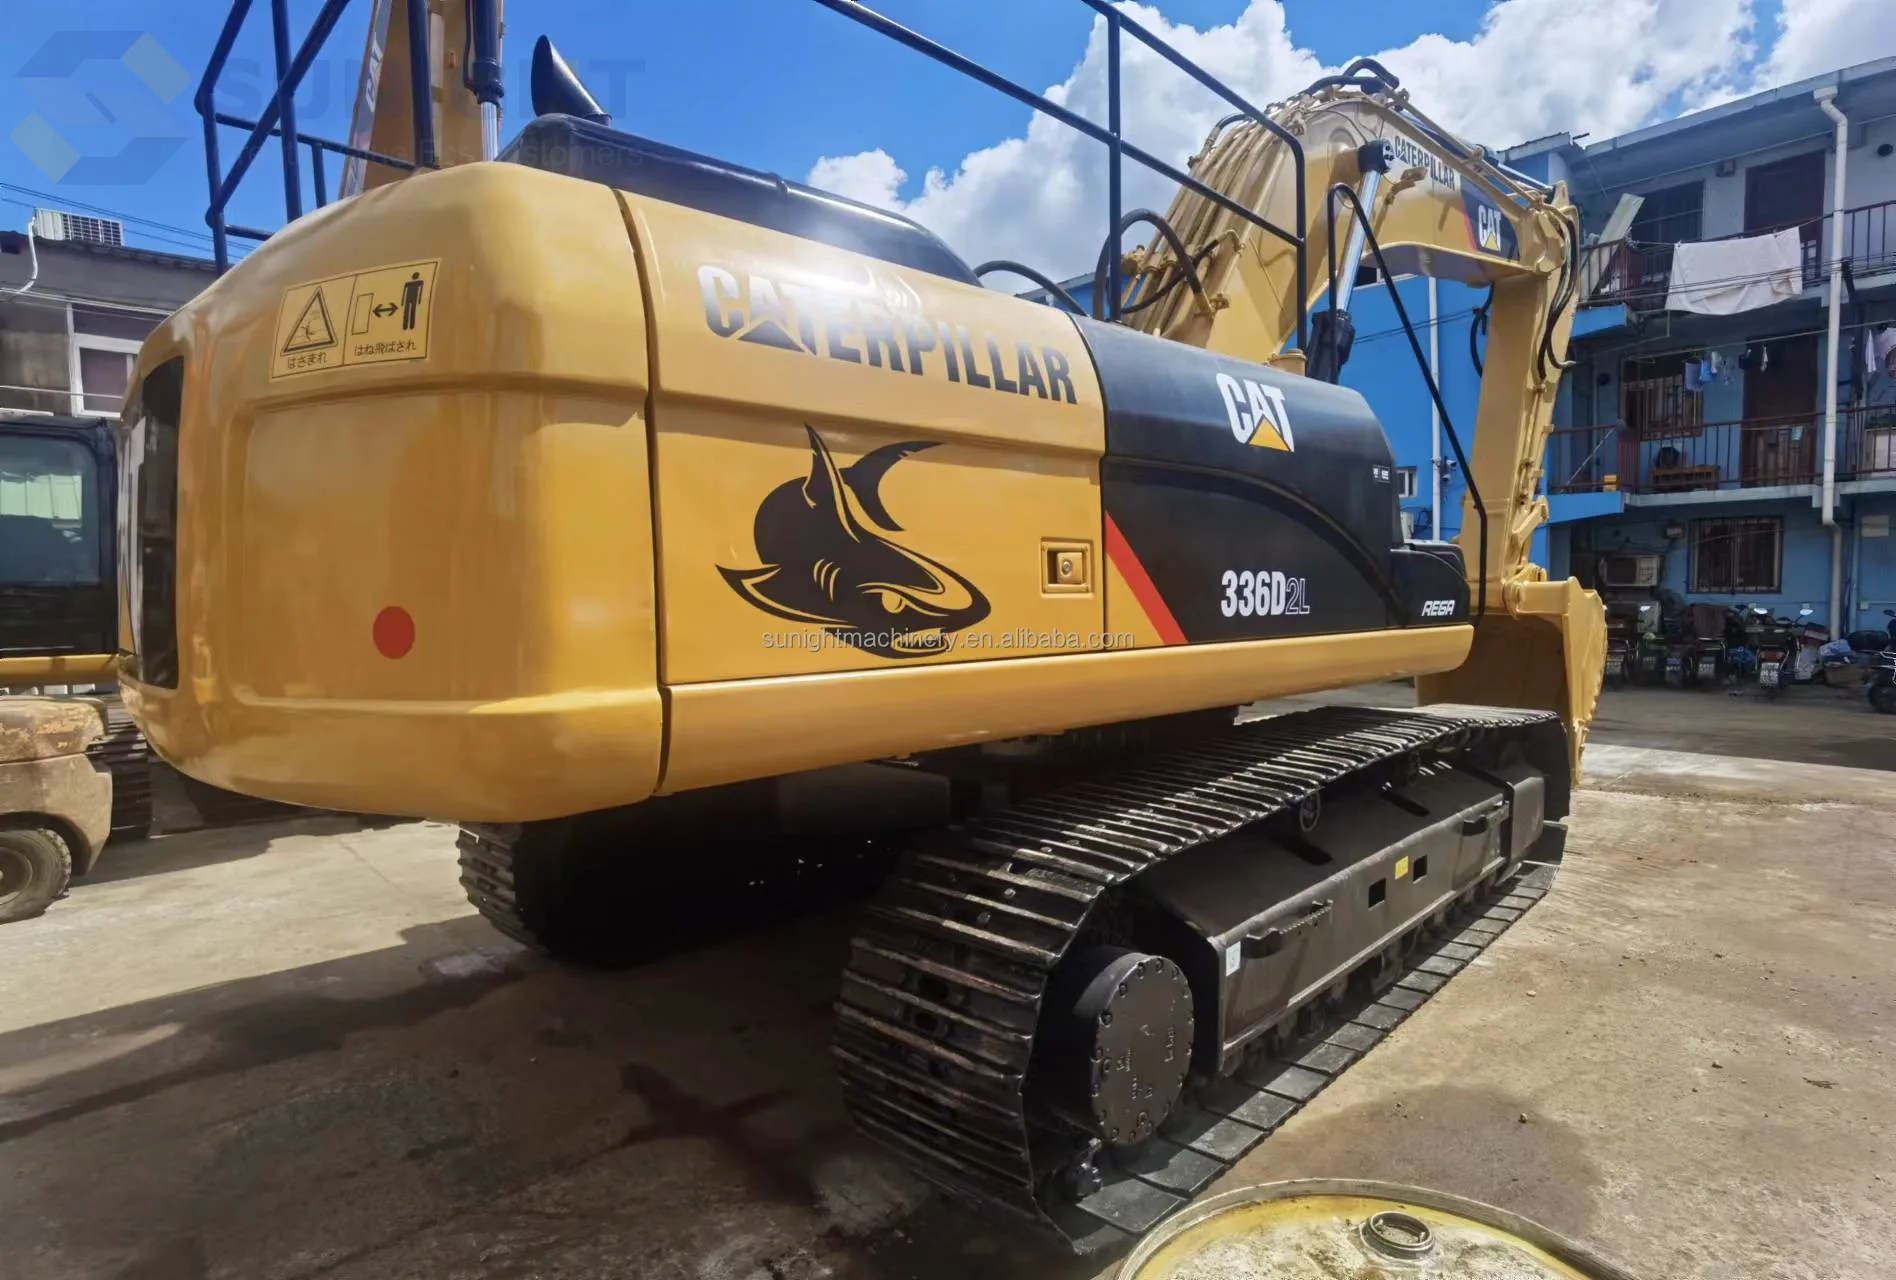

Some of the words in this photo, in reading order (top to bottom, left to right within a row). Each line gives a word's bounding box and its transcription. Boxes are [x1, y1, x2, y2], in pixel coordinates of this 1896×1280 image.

[1394, 135, 1456, 192] CATERPILLAR
[1478, 204, 1502, 251] CAT
[287, 351, 327, 369] はさまれ
[697, 264, 1078, 405] CATERPILLAR
[1215, 372, 1295, 453] CAT
[1421, 599, 1456, 617] REGA
